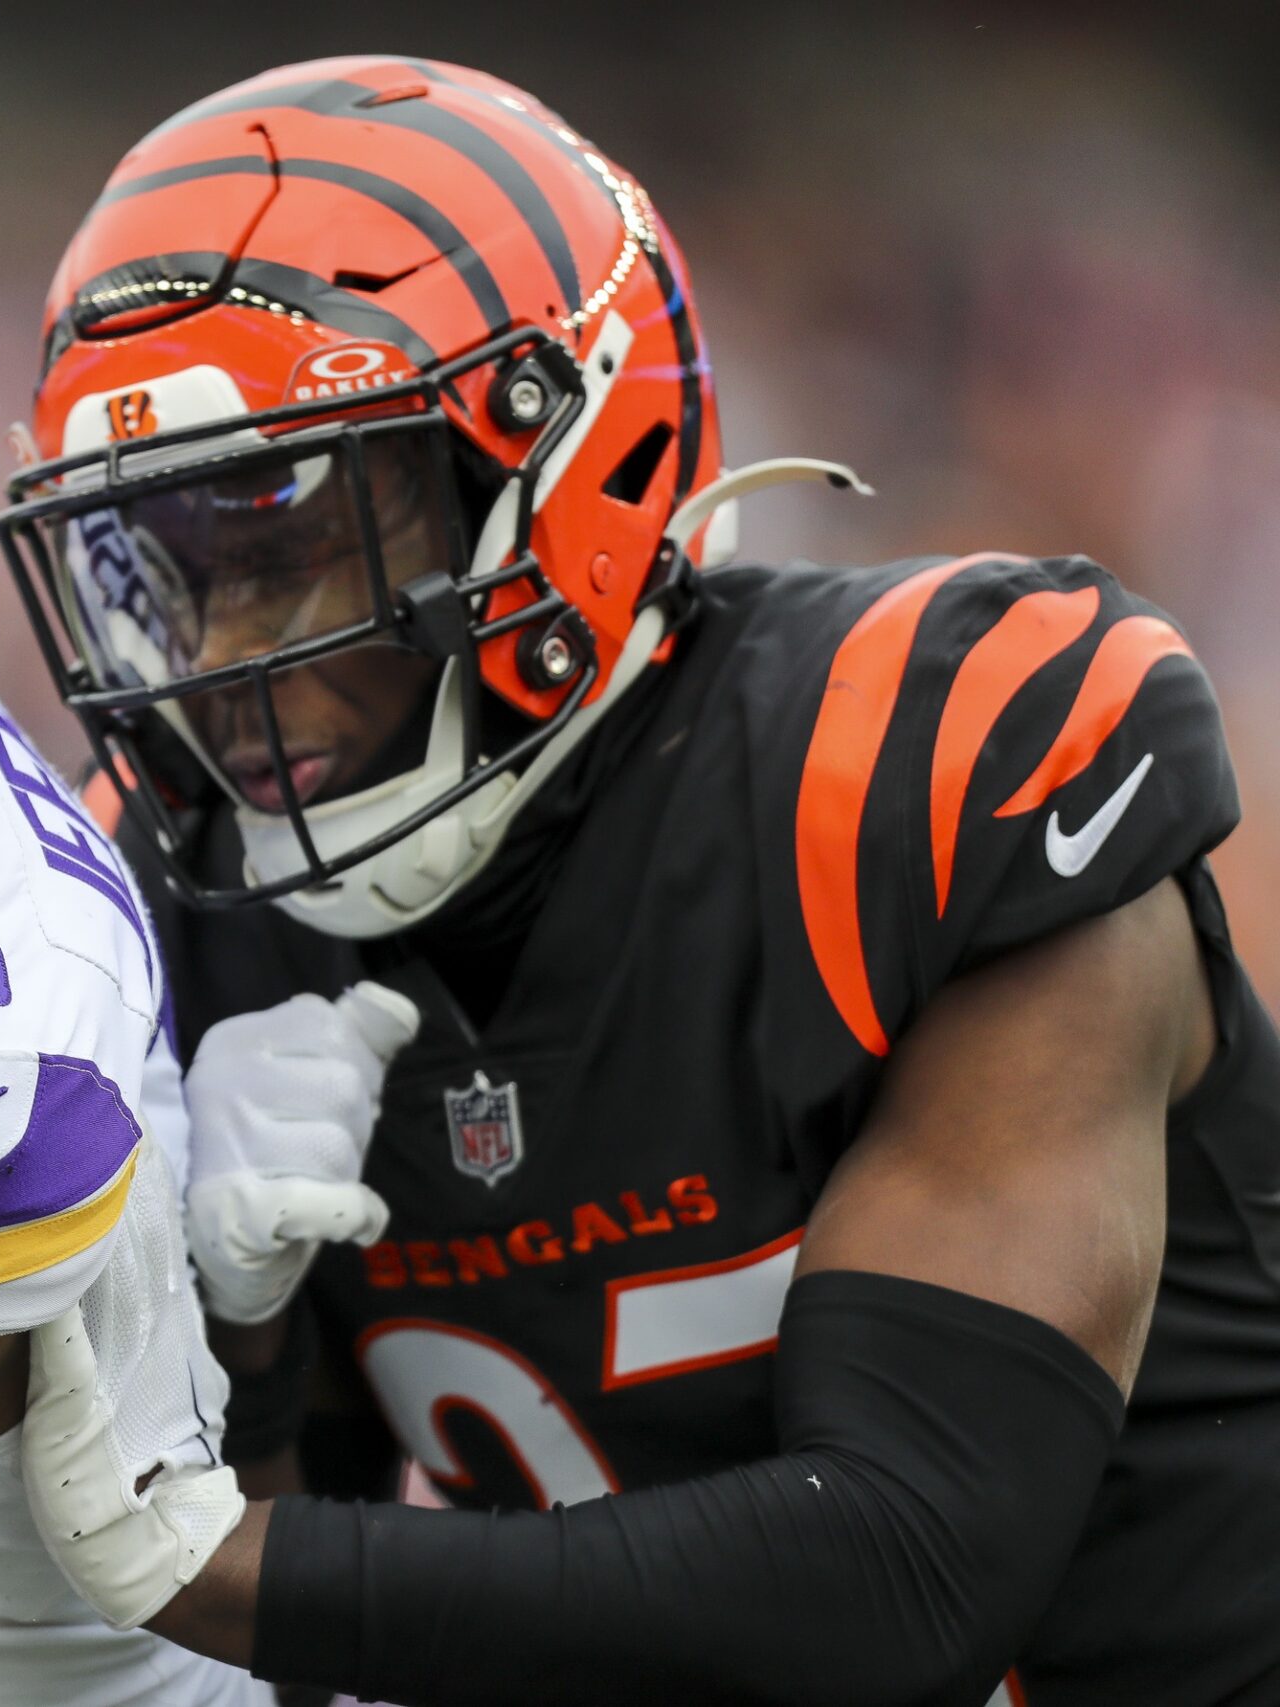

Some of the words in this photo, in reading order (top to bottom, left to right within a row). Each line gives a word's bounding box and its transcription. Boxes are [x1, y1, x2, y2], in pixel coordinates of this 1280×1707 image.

[296, 371, 405, 400] OAKLEY
[460, 1122, 512, 1168] NFL
[363, 1174, 718, 1288] BENGALS
